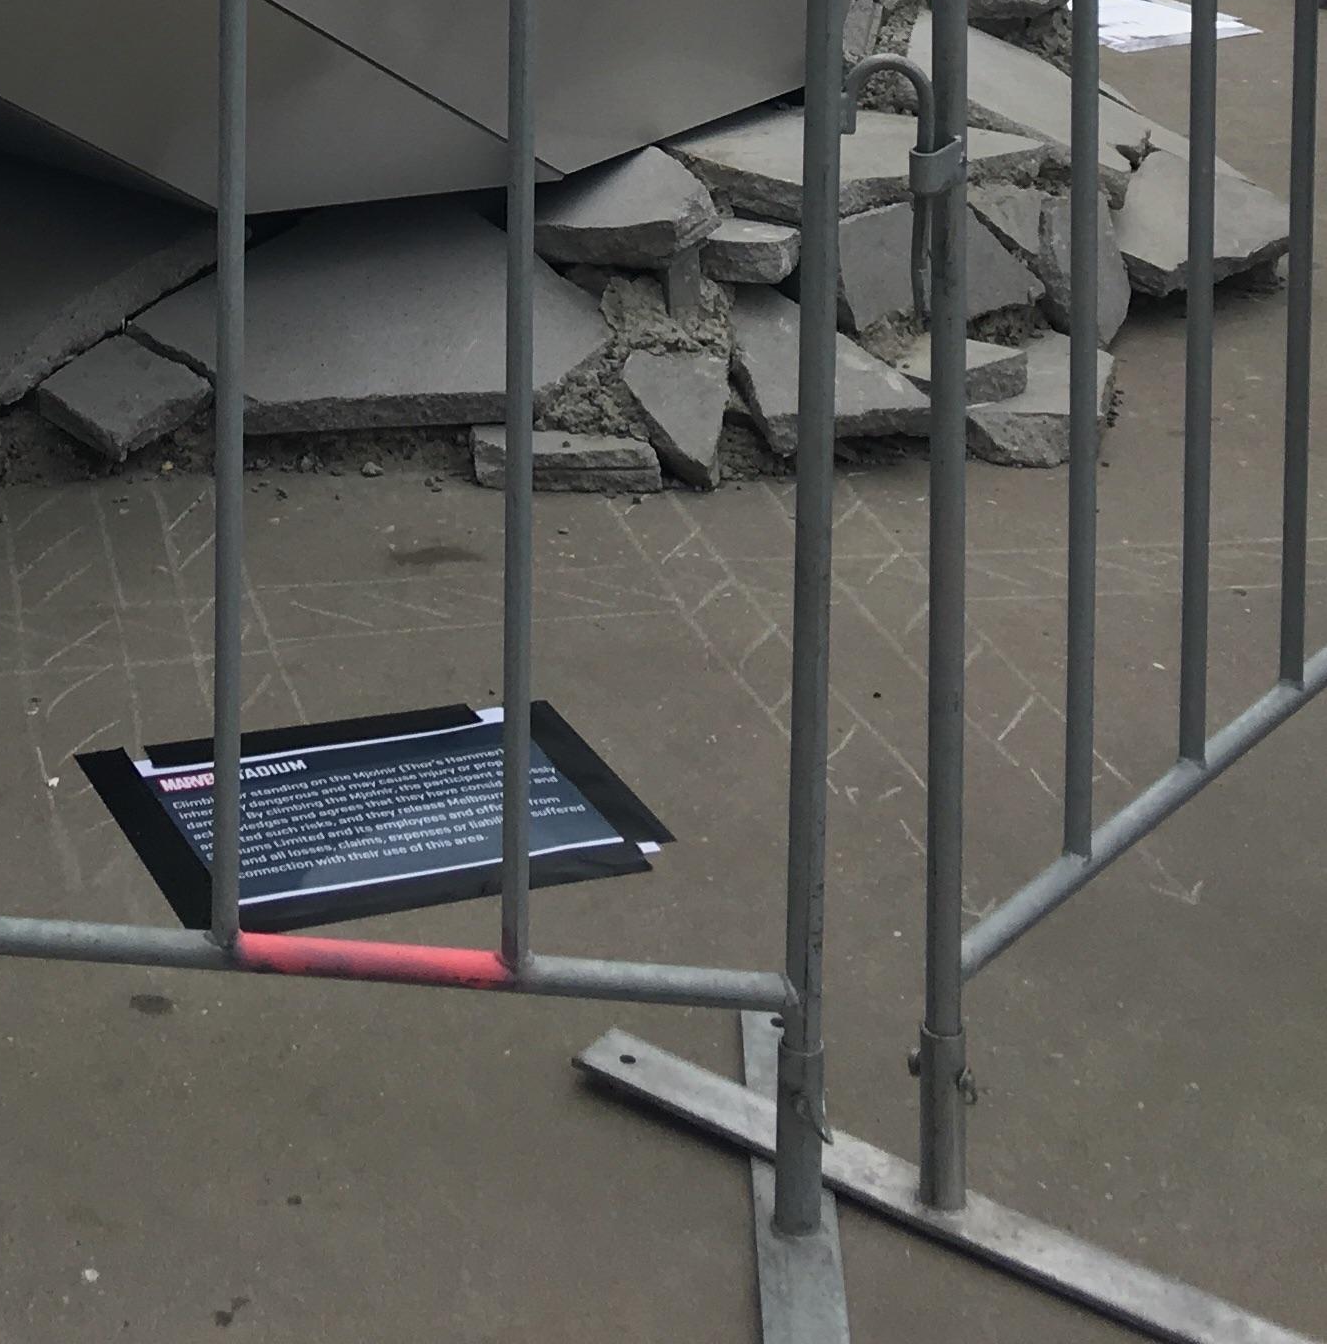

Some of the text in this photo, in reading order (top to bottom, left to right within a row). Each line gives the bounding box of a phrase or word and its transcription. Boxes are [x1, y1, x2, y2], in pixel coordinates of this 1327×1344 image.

[159, 759, 307, 791] MARVE TADIUM
[172, 797, 214, 809] Climbi
[250, 781, 309, 797] standing
[310, 778, 328, 787] on
[329, 775, 352, 783] the
[353, 767, 396, 779] Mjolnir
[398, 759, 445, 773] (Thor's
[246, 811, 263, 820] By
[266, 801, 323, 816] climbing
[325, 796, 347, 805] the
[348, 788, 398, 801] Mjolnir,
[399, 784, 421, 792] the
[423, 772, 493, 790] participant
[249, 790, 319, 808] dangerous
[321, 784, 346, 795] and
[348, 780, 375, 790] may
[379, 774, 417, 785] cause
[418, 768, 455, 778] injury
[473, 760, 503, 771] prop
[291, 811, 316, 822] and
[319, 803, 363, 816] agrees
[365, 797, 393, 808] that
[395, 793, 424, 803] they
[426, 787, 458, 799] have
[460, 779, 504, 792] consid
[534, 775, 558, 784] and
[241, 854, 267, 866] and
[270, 850, 286, 861] all
[287, 844, 337, 857] losses,
[338, 837, 387, 849] claims,
[388, 827, 451, 842] expenses
[453, 823, 466, 832] or
[531, 804, 586, 817] suffered
[265, 826, 298, 838] such
[300, 820, 337, 831] risks,
[338, 813, 364, 824] and
[365, 809, 395, 819] they
[397, 801, 445, 814] release
[447, 792, 504, 806] Melbour
[273, 832, 325, 847] Limited
[328, 827, 353, 838] and
[354, 825, 373, 834] its
[375, 814, 447, 829] employees
[449, 808, 474, 819] and
[238, 834, 488, 879] connection with their use of this area.
